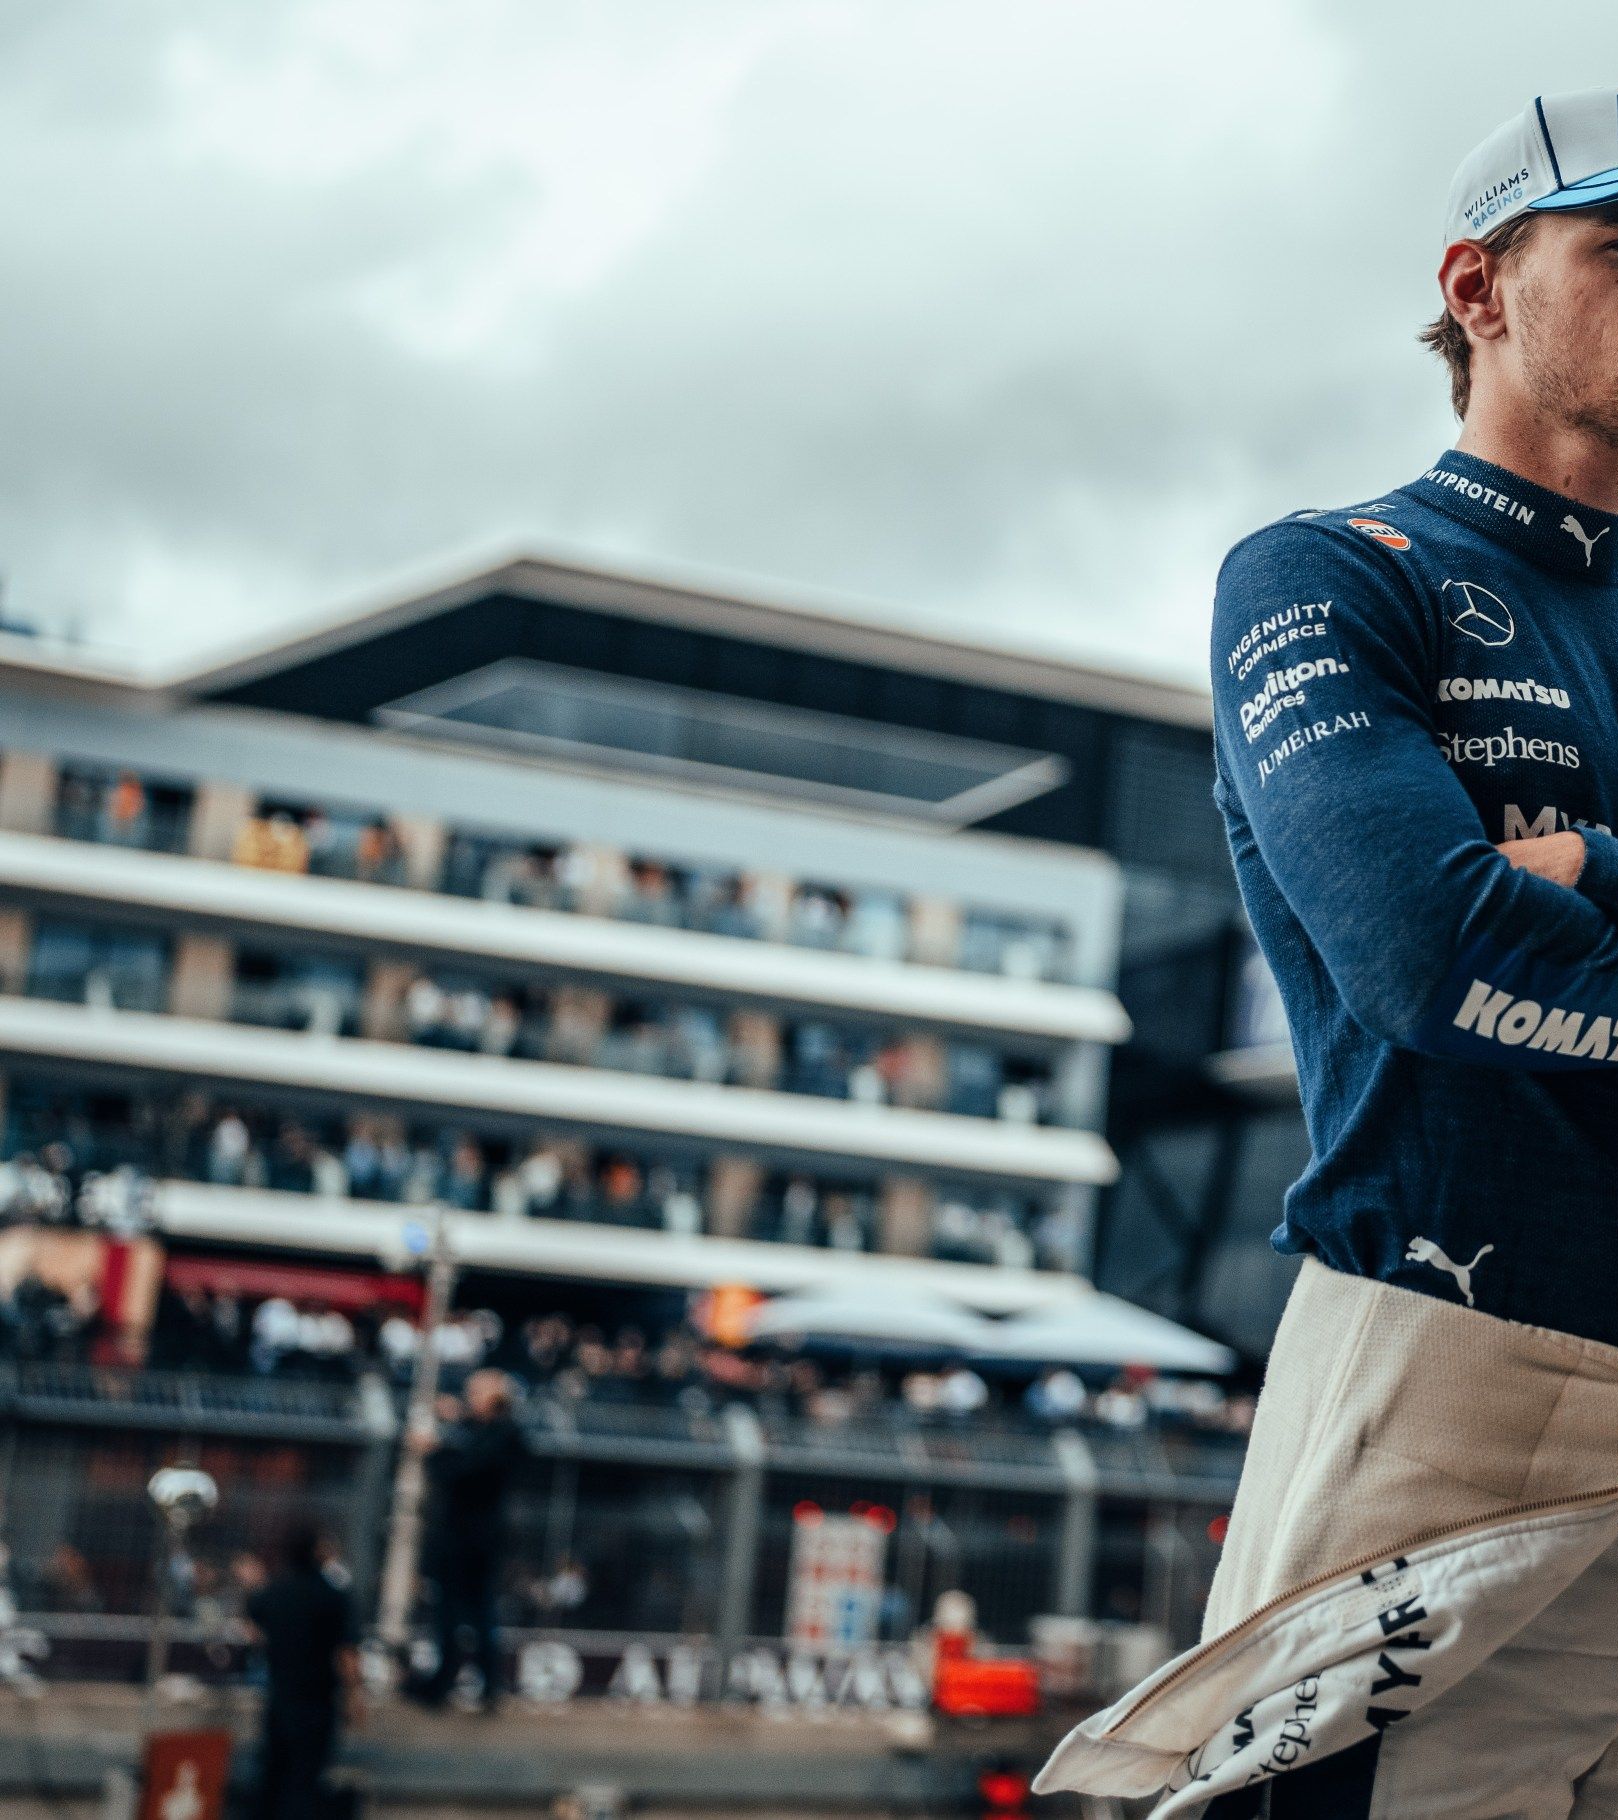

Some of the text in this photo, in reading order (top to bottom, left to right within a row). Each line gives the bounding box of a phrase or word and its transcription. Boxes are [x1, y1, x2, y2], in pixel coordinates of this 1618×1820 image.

[1464, 168, 1529, 221] WILLIAMS
[1472, 187, 1523, 230] RACING
[1422, 469, 1535, 526] MYPROTEIN
[1238, 623, 1327, 680] COMMERCE
[1245, 690, 1306, 744] Ventures
[1436, 677, 1571, 709] KOMATSU
[1257, 711, 1371, 788] JUMEIRAH
[1437, 726, 1581, 769] Stephens
